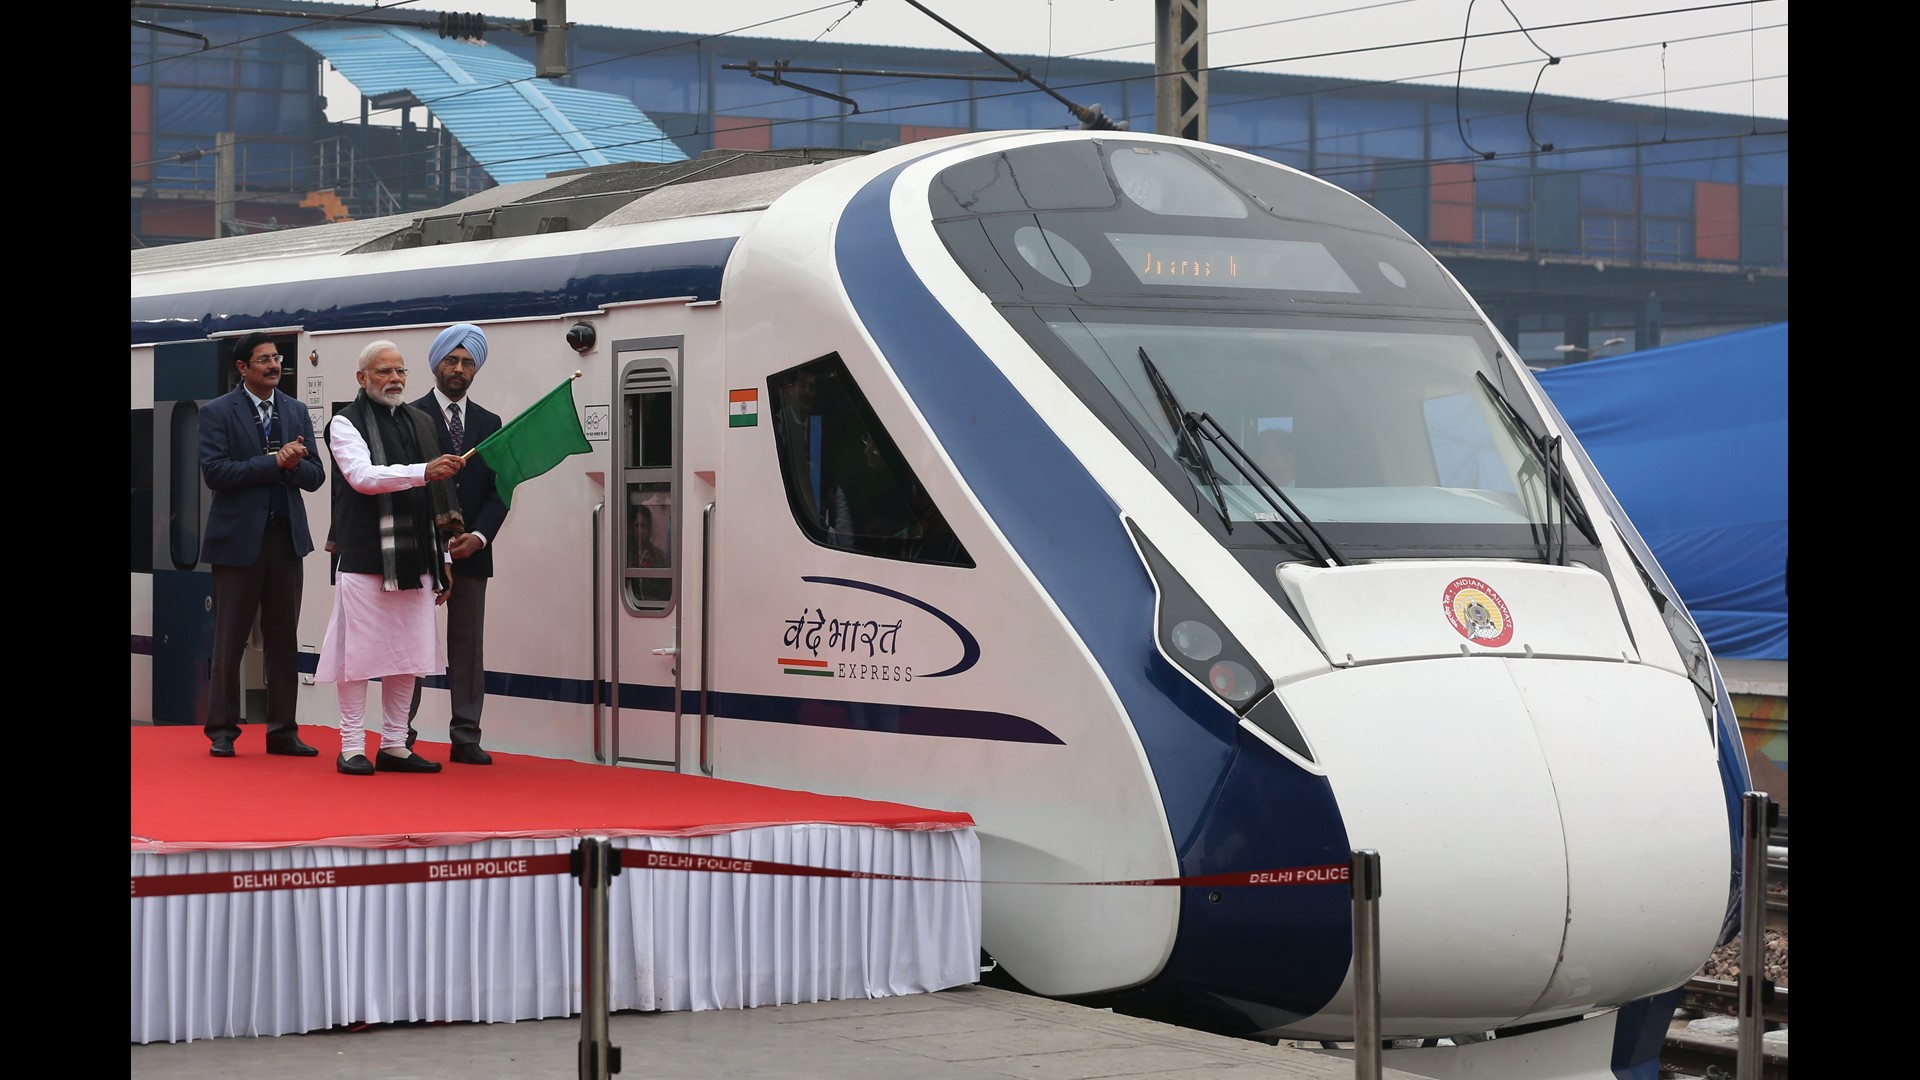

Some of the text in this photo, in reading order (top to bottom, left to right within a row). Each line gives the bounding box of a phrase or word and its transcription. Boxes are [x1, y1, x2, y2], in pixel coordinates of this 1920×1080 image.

[1453, 579, 1512, 628] INDIAN RAILWAYS
[838, 663, 913, 682] EXPRESS
[429, 860, 528, 878] DELHI POLICE
[647, 854, 752, 871] DELHI POLICE
[233, 870, 336, 889] DELHI POLICE
[1249, 868, 1349, 883] DELHI POLICE
